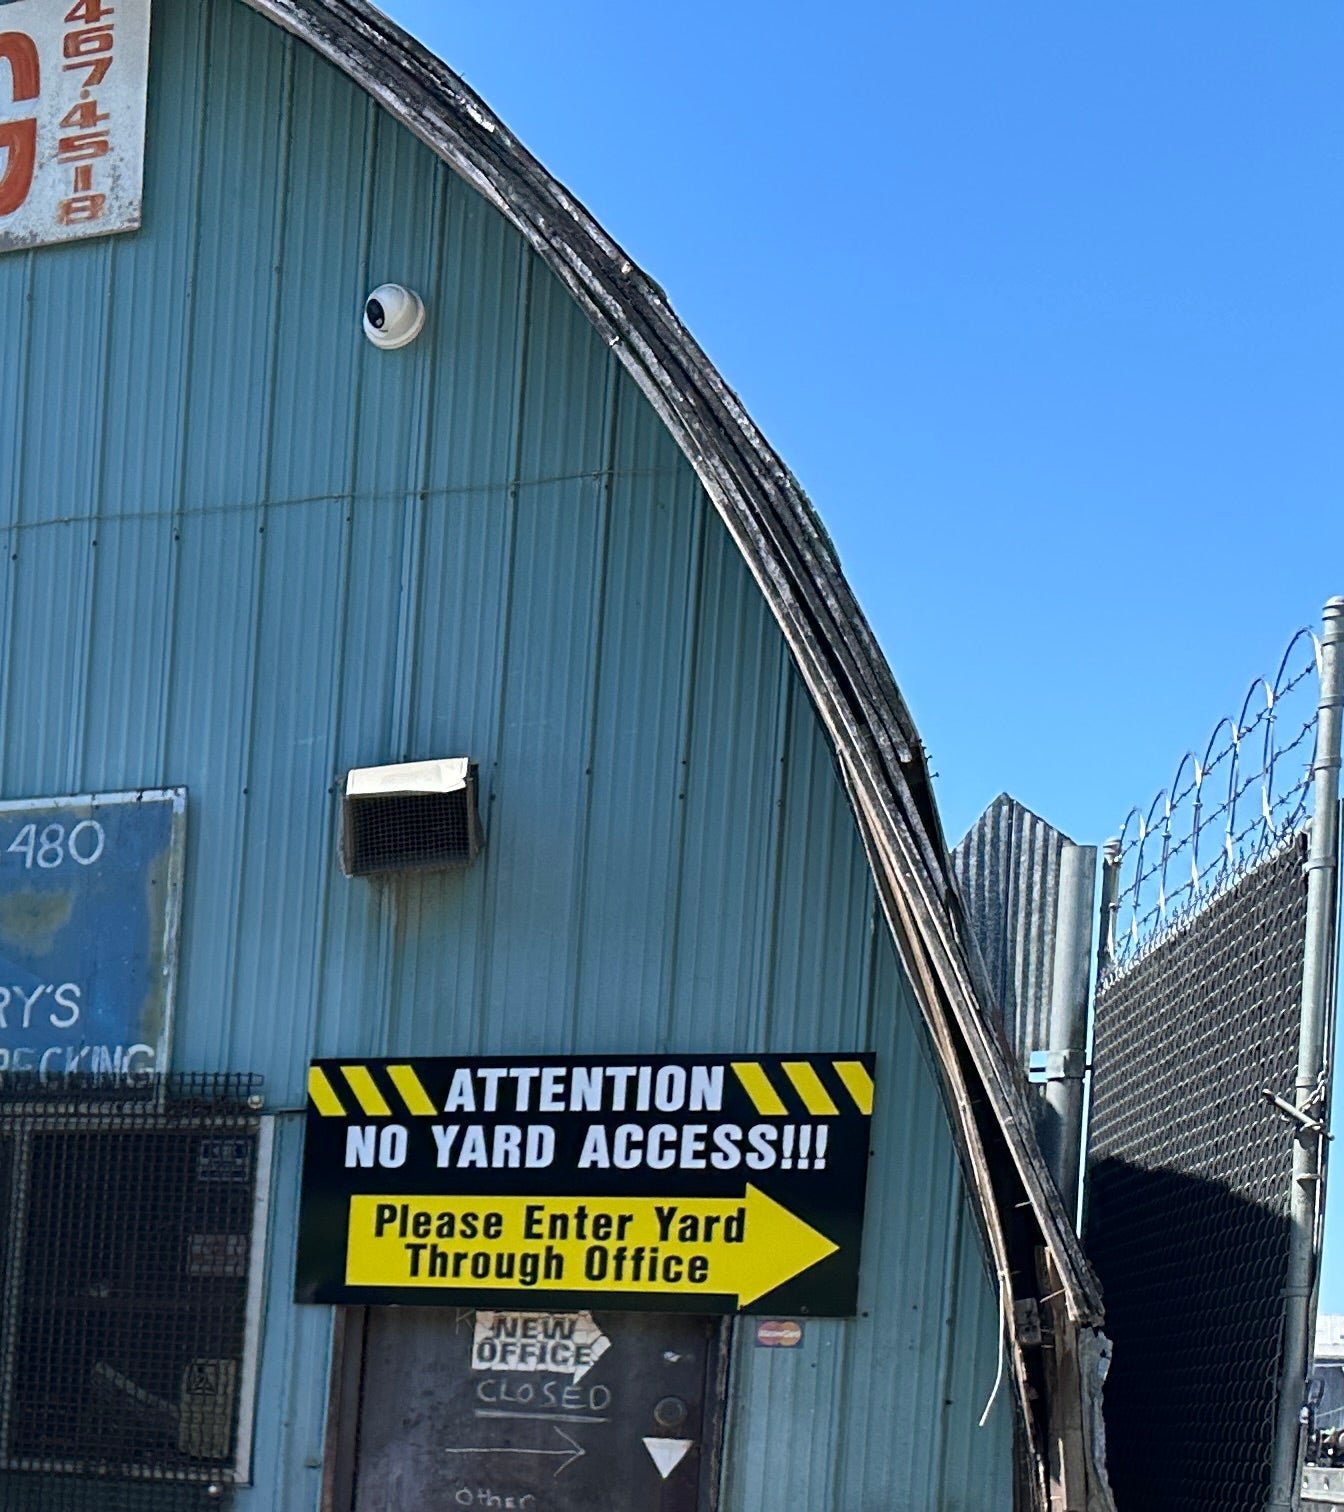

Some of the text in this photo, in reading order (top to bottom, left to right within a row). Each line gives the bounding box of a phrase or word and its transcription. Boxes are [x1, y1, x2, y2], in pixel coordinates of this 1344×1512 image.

[443, 1065, 725, 1113] ATTENTION
[344, 1123, 830, 1171] NO YARD ACCESS!!!
[374, 1203, 747, 1244] Please Enter Yard
[403, 1242, 709, 1287] Through Office
[494, 1315, 577, 1340] NEW
[476, 1337, 593, 1366] OFFICE
[476, 1378, 611, 1410] CLOSED
[455, 1487, 536, 1509] Other
